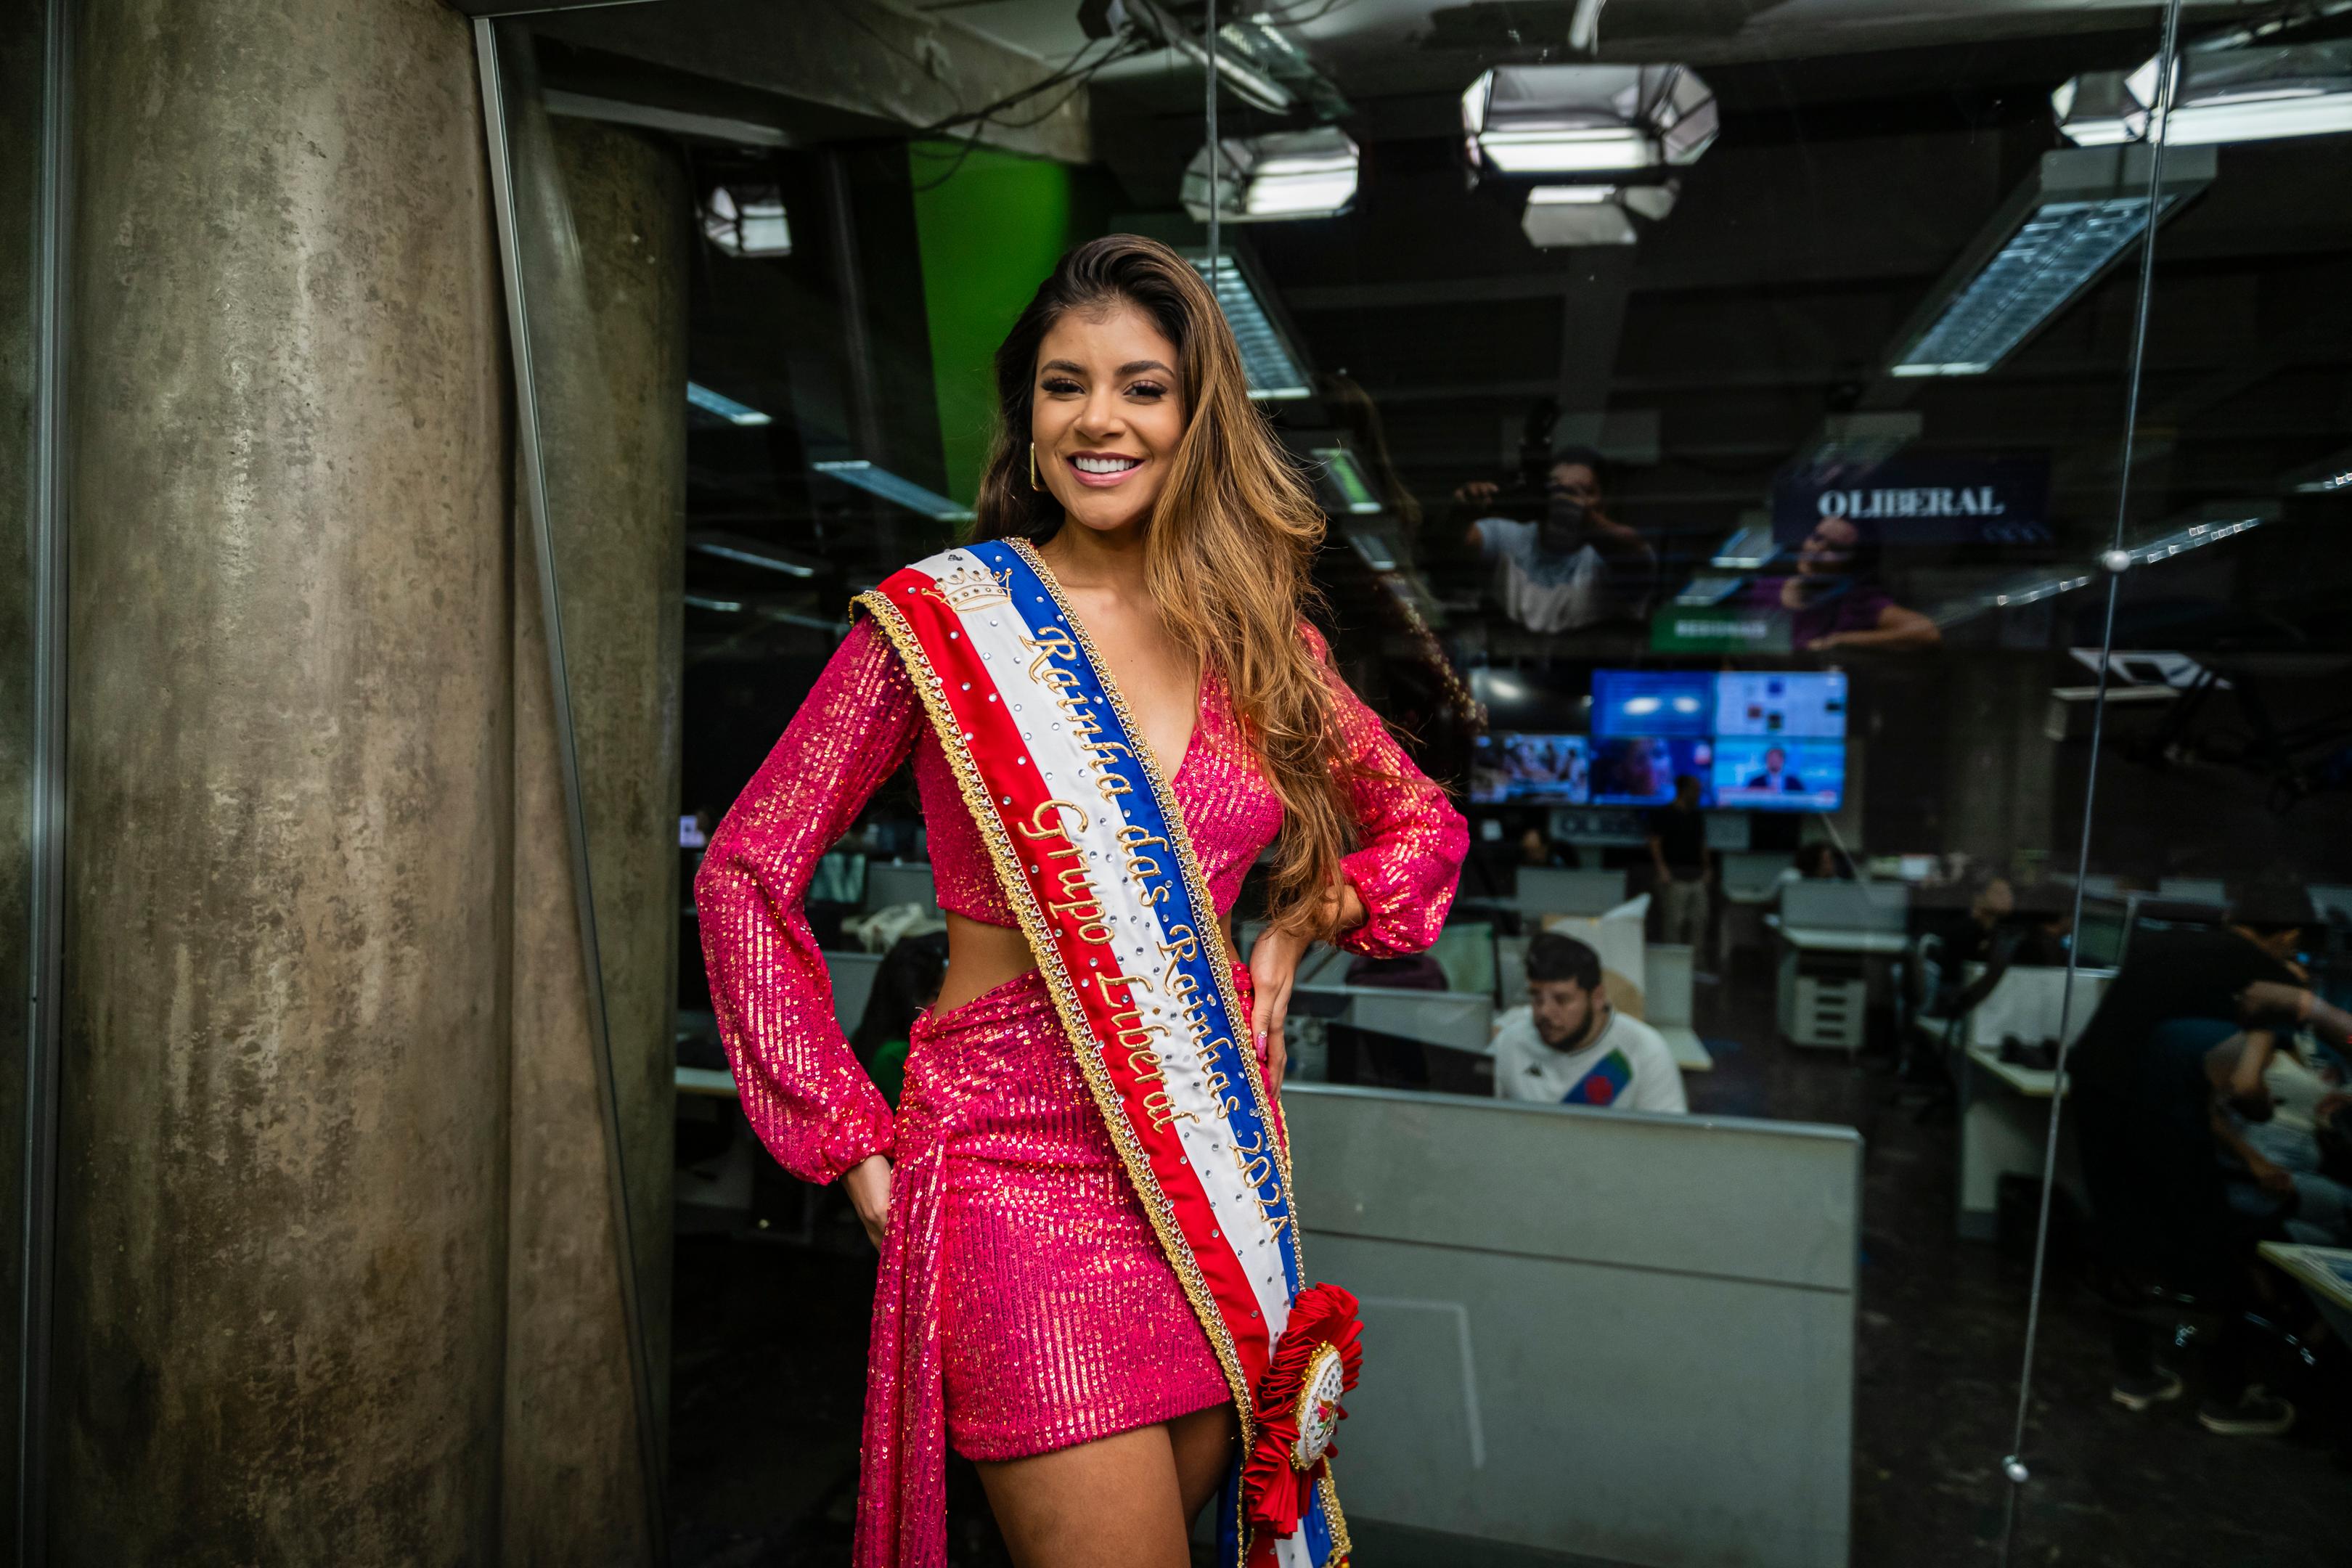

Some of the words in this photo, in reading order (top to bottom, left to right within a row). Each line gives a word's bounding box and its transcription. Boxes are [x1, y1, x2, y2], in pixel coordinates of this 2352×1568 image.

[1018, 626, 1132, 804] Rainha
[1116, 825, 1169, 908] das
[1156, 924, 1241, 1119] Rainhas
[1229, 1131, 1289, 1244] 2024
[1018, 799, 1116, 945] Grupo
[1095, 972, 1200, 1135] Liberal
